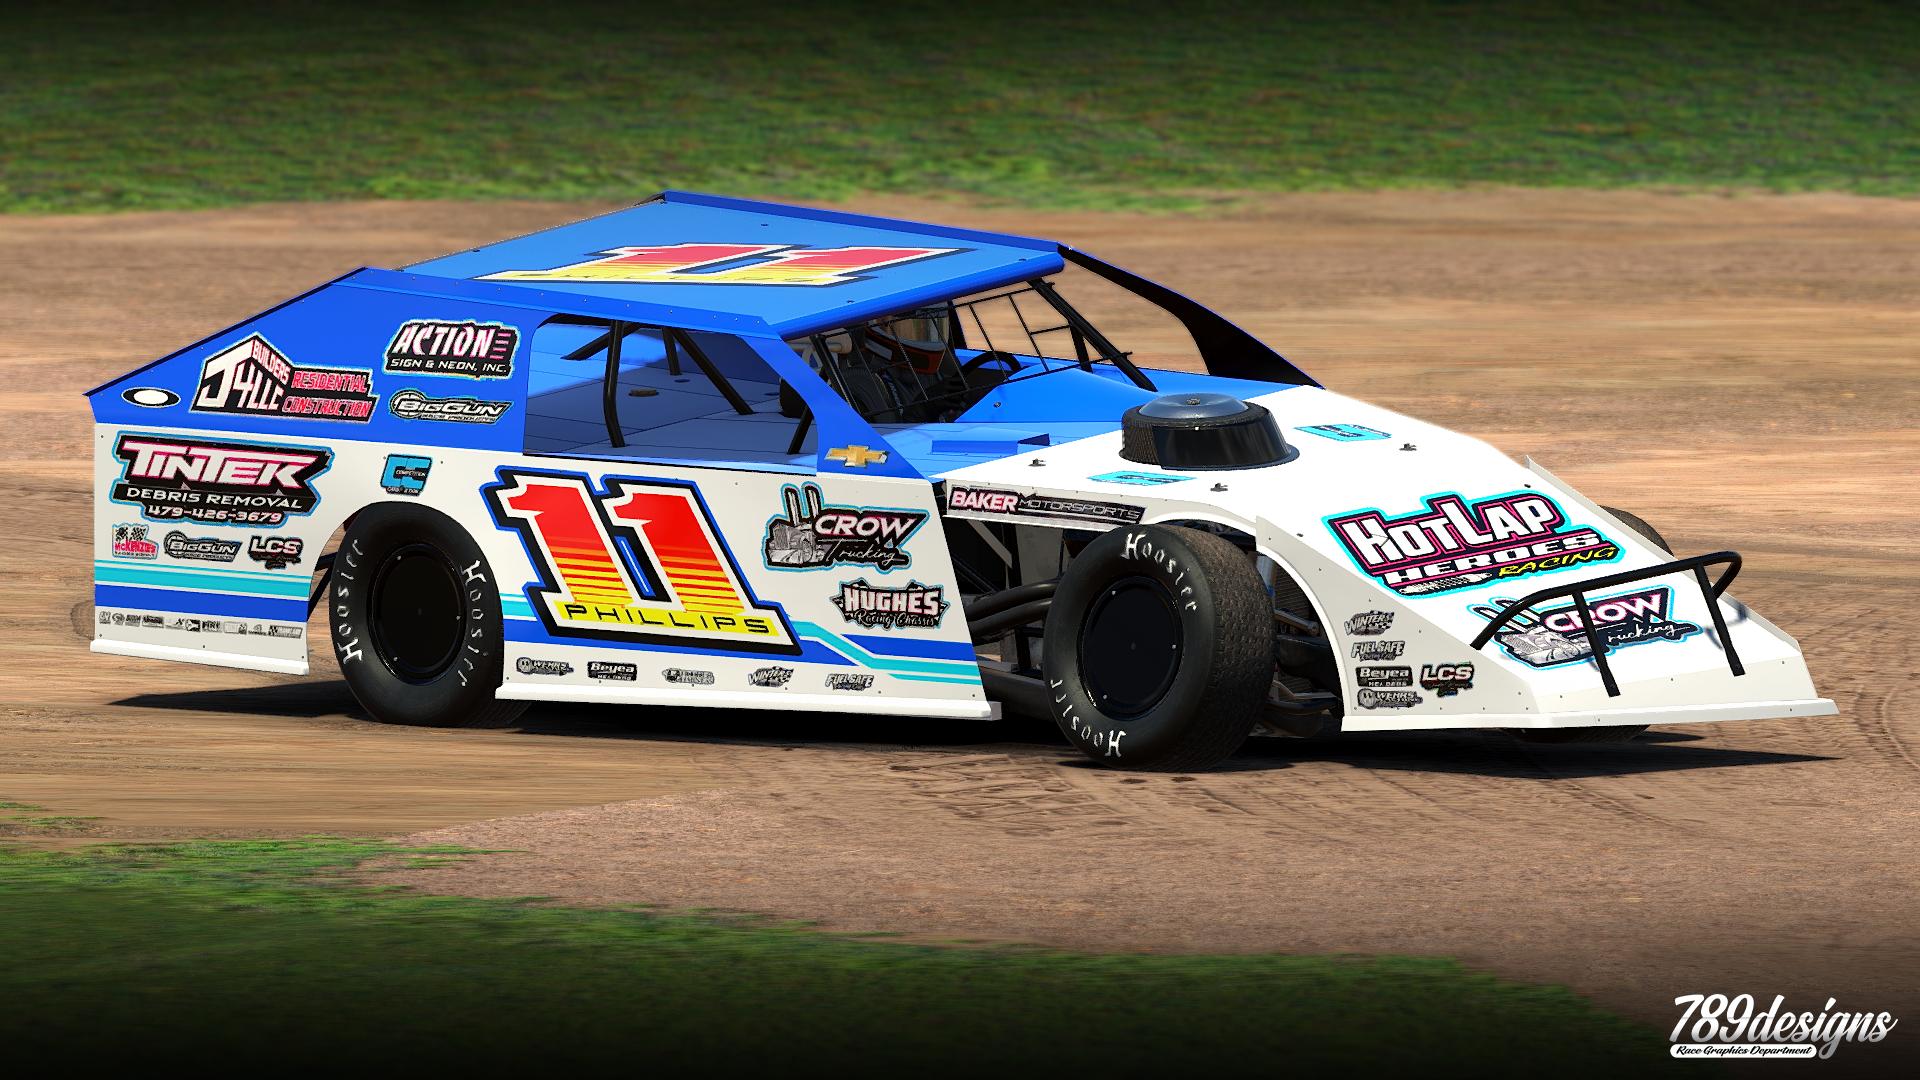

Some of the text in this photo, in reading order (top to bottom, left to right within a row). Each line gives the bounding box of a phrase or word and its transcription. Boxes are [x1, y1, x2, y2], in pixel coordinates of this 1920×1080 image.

[391, 324, 496, 359] ACTION
[252, 339, 291, 386] BUILDERS
[390, 358, 507, 373] SIGN & NEON, INC.
[291, 370, 368, 393] RESIDENTIAL
[282, 396, 373, 417] CONSTRUCTION
[122, 440, 318, 489] TINTEK
[126, 487, 303, 509] DEBRIS REMOVAL
[951, 490, 1142, 520] BAKER MOTORSPORTS
[148, 505, 283, 523] 479-426-3679
[815, 514, 918, 539] CROW
[250, 538, 302, 554] LCS
[496, 474, 750, 614] 11
[817, 537, 906, 567] Trucking
[1384, 533, 1601, 585] HEROES
[1498, 546, 1617, 577] RACING
[843, 587, 940, 616] HUGHES
[563, 603, 770, 634] PHILLIPS
[854, 608, 935, 627] Racing Chassis
[1351, 641, 1377, 658] FUEL
[1377, 641, 1405, 656] SAFE
[825, 674, 850, 688] FUEL
[849, 674, 875, 689] SAFE
[1421, 665, 1474, 682] LCS
